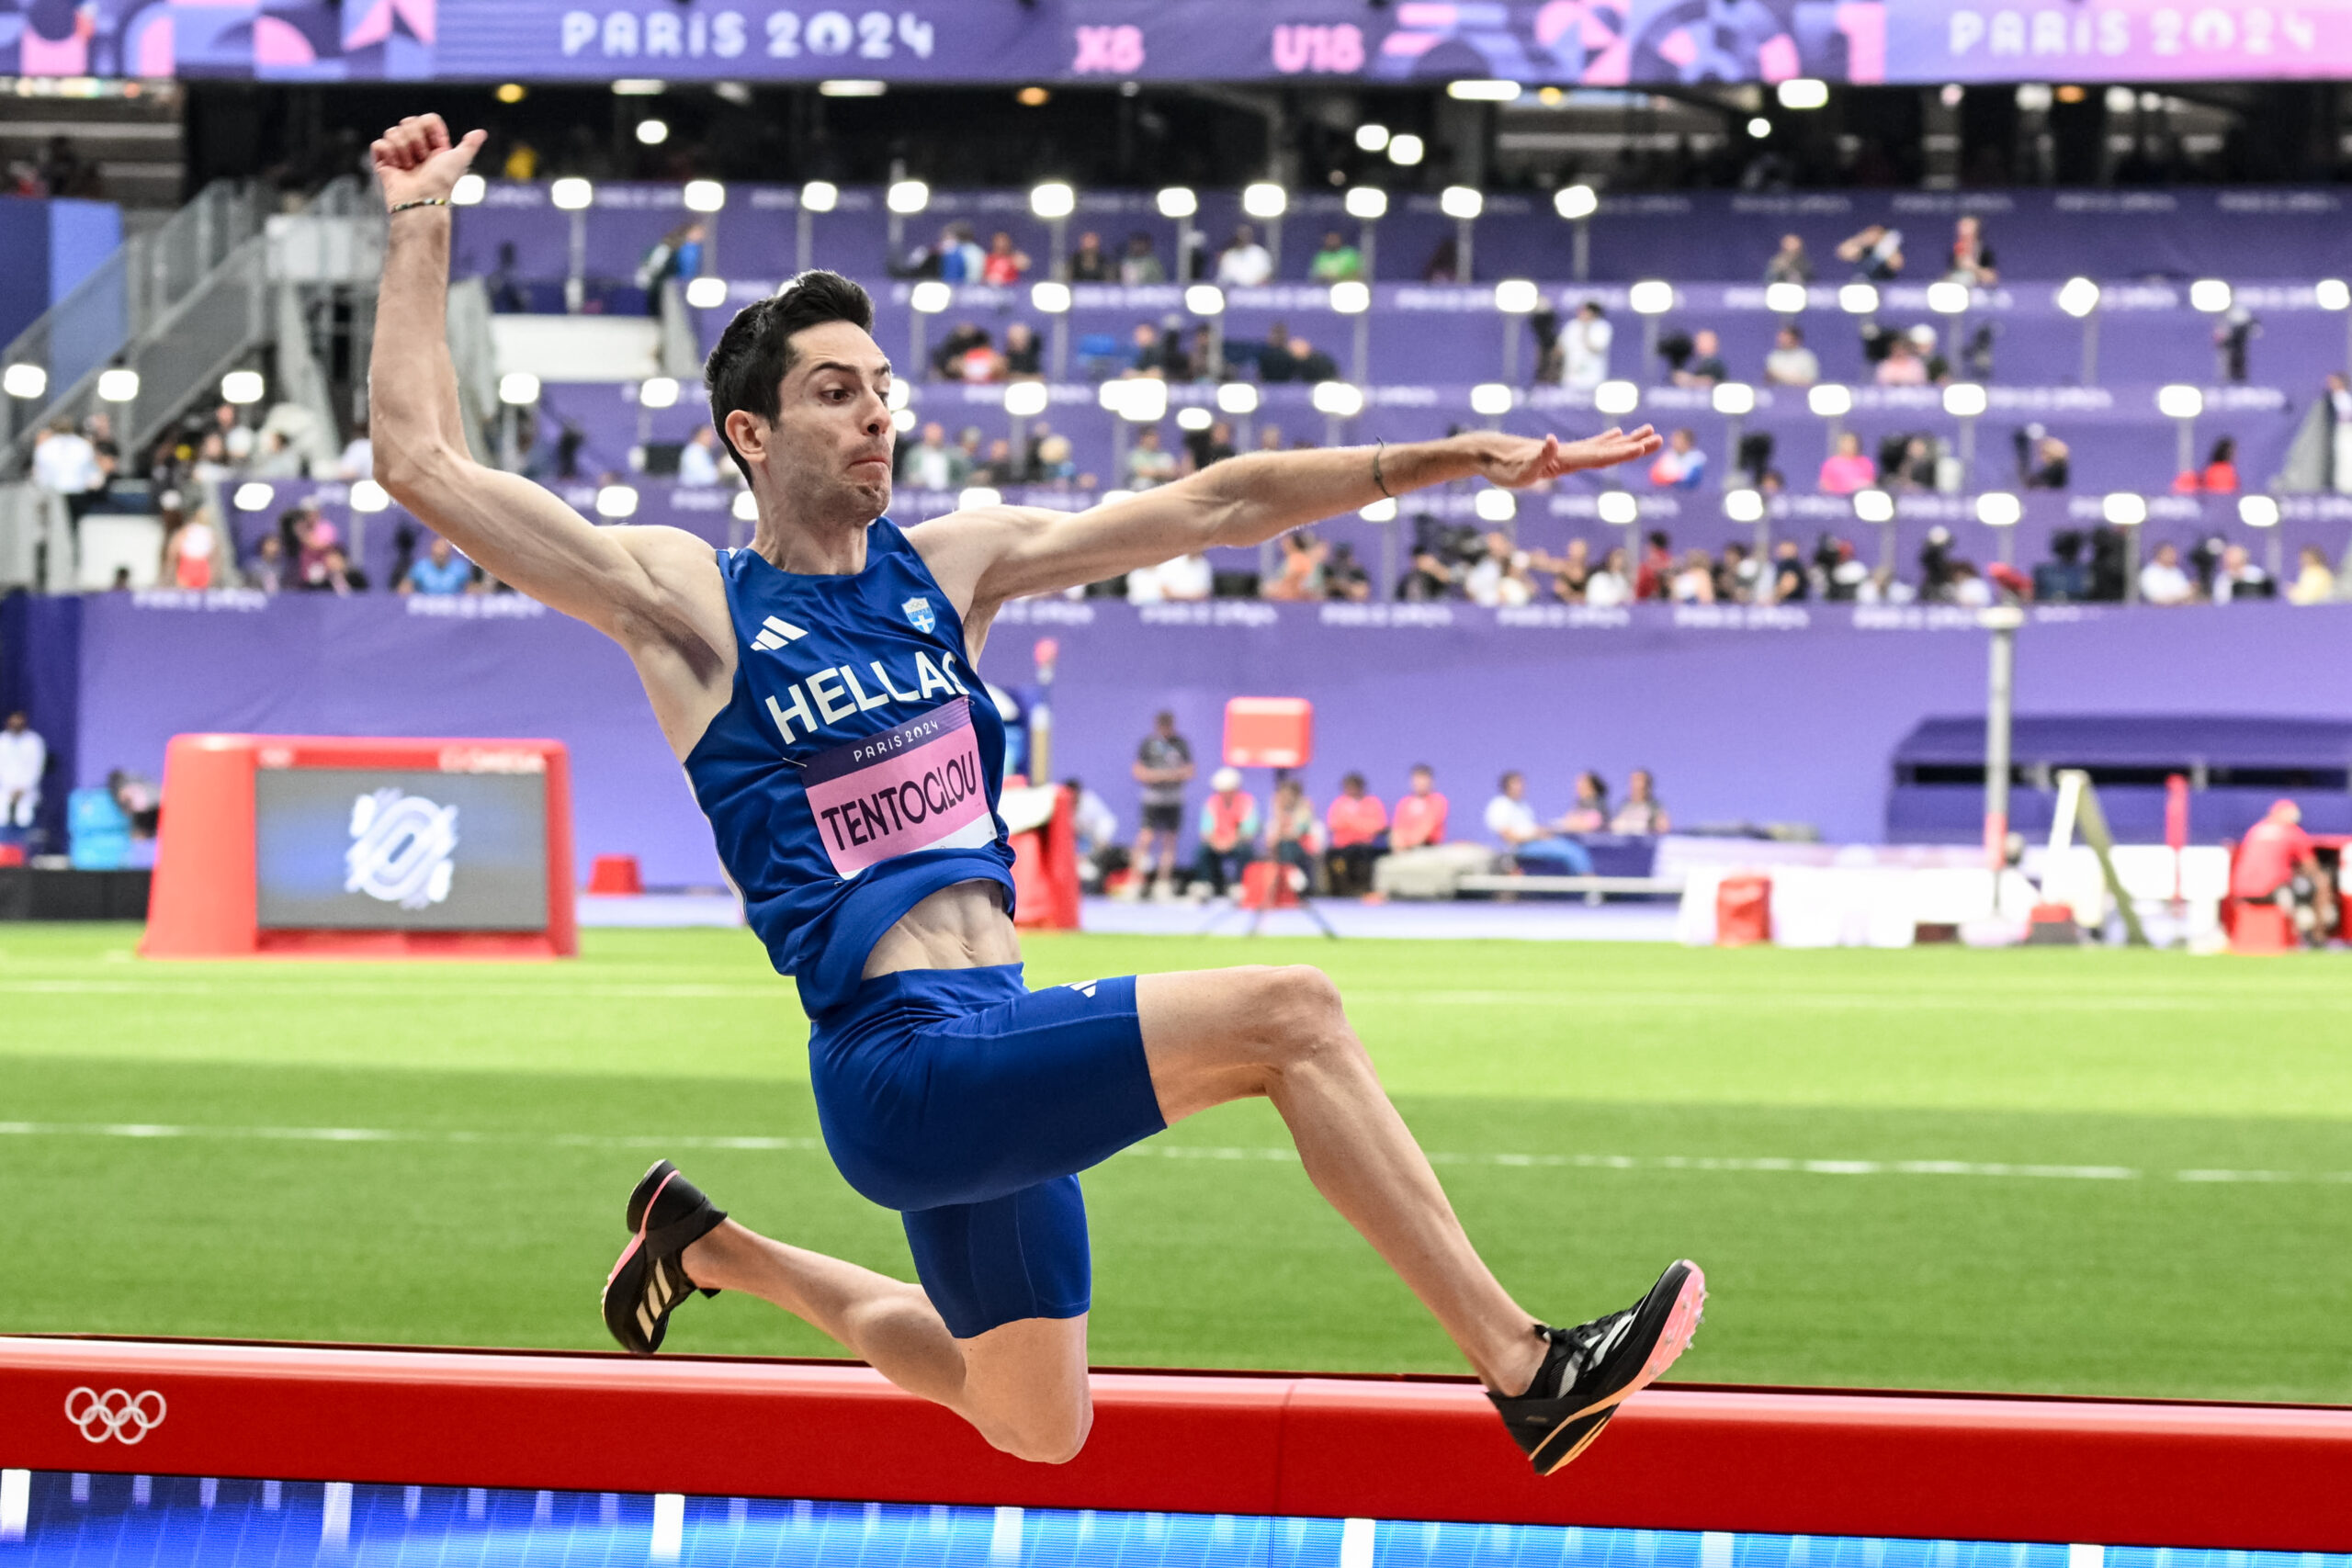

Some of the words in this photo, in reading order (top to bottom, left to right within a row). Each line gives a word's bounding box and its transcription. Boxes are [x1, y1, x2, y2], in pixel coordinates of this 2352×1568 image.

[560, 9, 748, 59] PARIS
[765, 10, 934, 60] 2024
[1272, 24, 1365, 73] U18
[1949, 8, 2131, 56] PARIS
[2150, 7, 2315, 55] 2024
[853, 735, 902, 762] PARIS
[905, 719, 939, 743] 2024
[820, 750, 977, 851] TENTOGLOU
